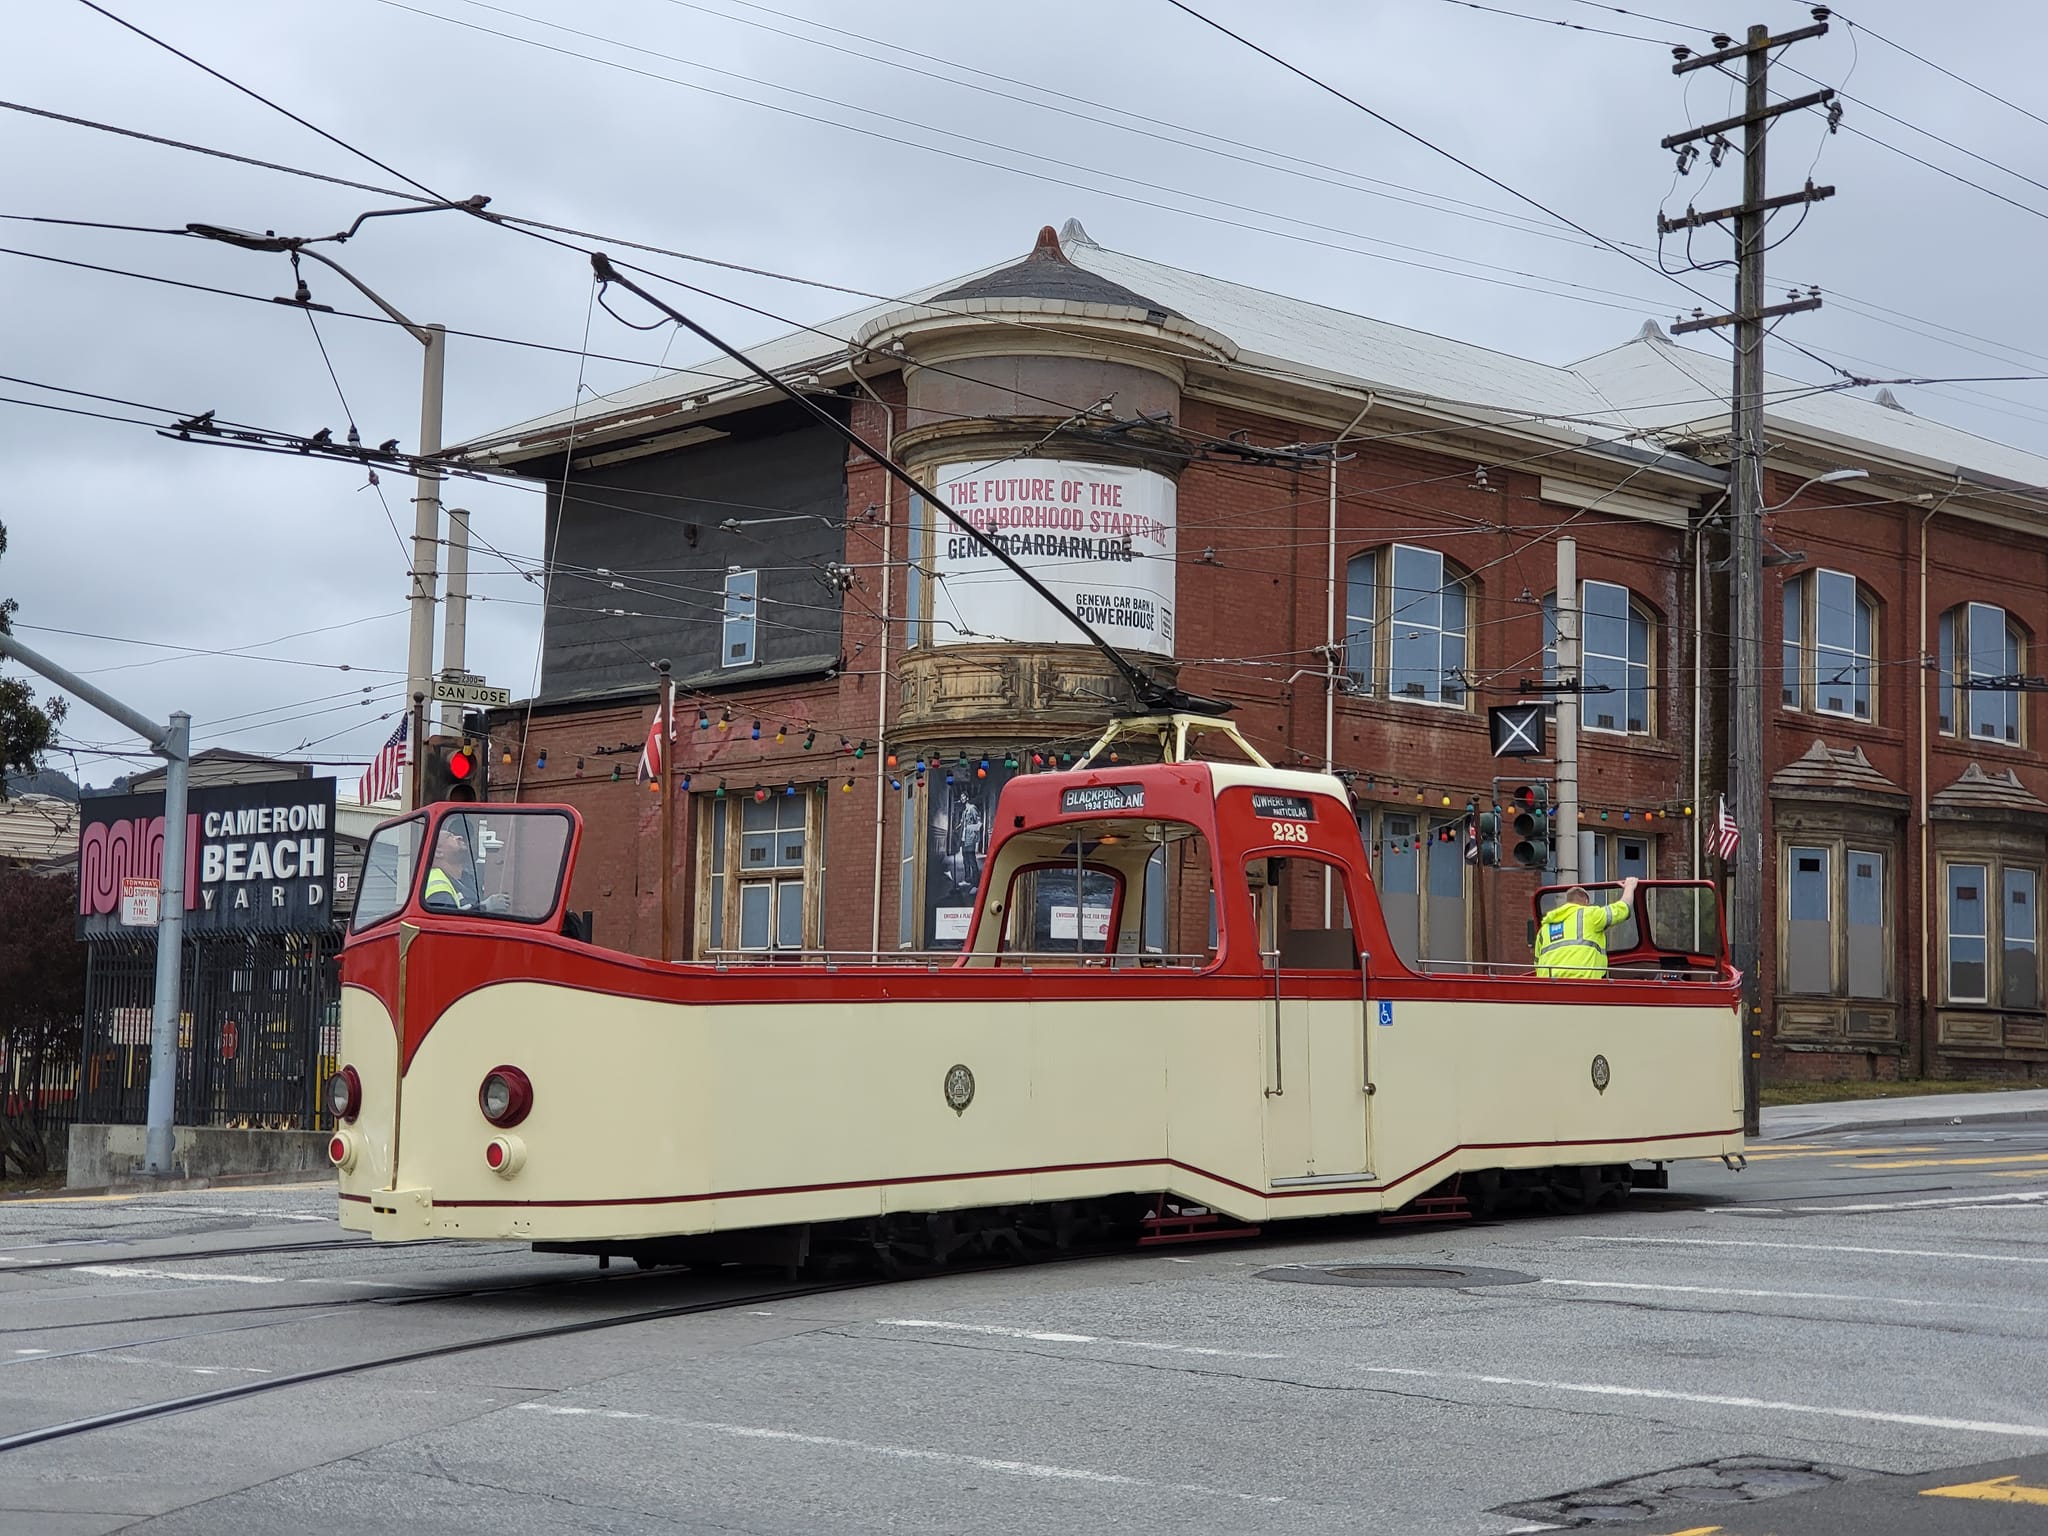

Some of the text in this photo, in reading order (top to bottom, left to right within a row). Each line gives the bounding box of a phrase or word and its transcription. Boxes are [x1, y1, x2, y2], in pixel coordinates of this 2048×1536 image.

[949, 479, 1123, 508] THE FUTURE OF THE
[1090, 511, 1150, 539] STARTS
[1076, 593, 1111, 608] GENEVA
[1113, 596, 1131, 609] CAR
[1132, 598, 1150, 611] BARN
[1076, 606, 1155, 632] POWERHOUSE
[438, 685, 507, 704] SAN JOSE
[1066, 788, 1118, 806] BLACKPOOL
[1085, 791, 1145, 811] 1934 ENGLAND
[204, 803, 327, 839] CAMERON
[1272, 822, 1309, 843] 228
[203, 837, 326, 883] BEACH
[123, 886, 157, 897] NO STOPPING
[339, 876, 345, 888] 8
[133, 899, 148, 907] ANY
[202, 884, 324, 911] YARD
[133, 907, 148, 916] TIME
